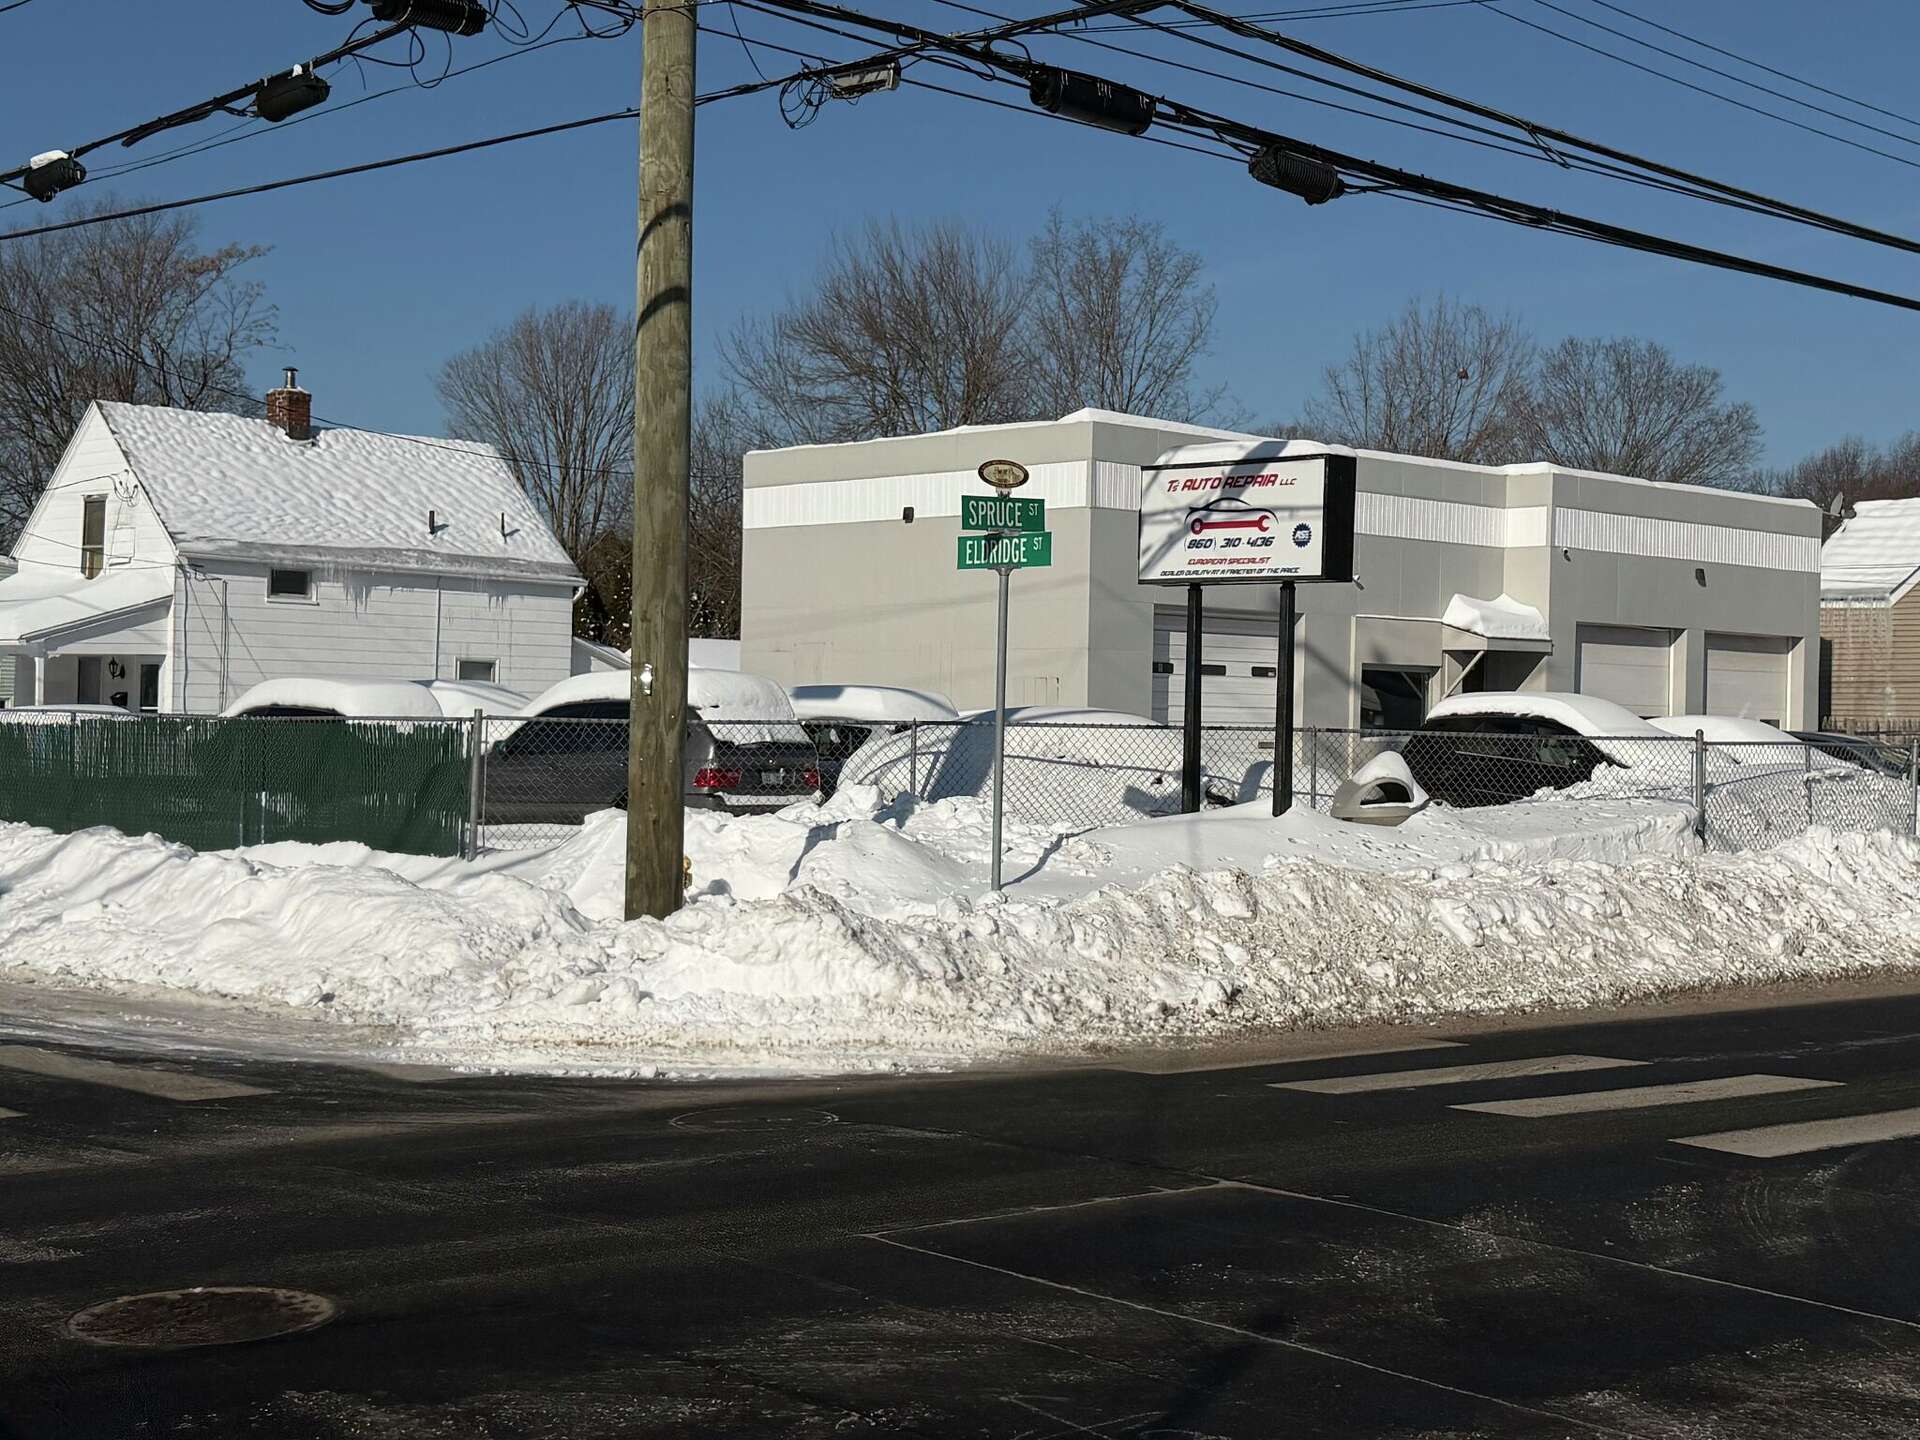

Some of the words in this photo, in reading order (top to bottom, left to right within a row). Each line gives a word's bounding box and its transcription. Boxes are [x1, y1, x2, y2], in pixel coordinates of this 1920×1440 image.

[1180, 476, 1222, 491] AUTO
[1222, 473, 1279, 489] REPAIR
[1279, 477, 1297, 486] LLC
[968, 500, 1022, 527] SPRUCE
[1028, 503, 1039, 516] ST
[965, 538, 1028, 565] ELDRIDGE
[1033, 537, 1043, 551] ST
[1184, 536, 1217, 552] (860)
[1187, 557, 1228, 566] EUROPEAN
[1227, 556, 1272, 565] SPECIALIST
